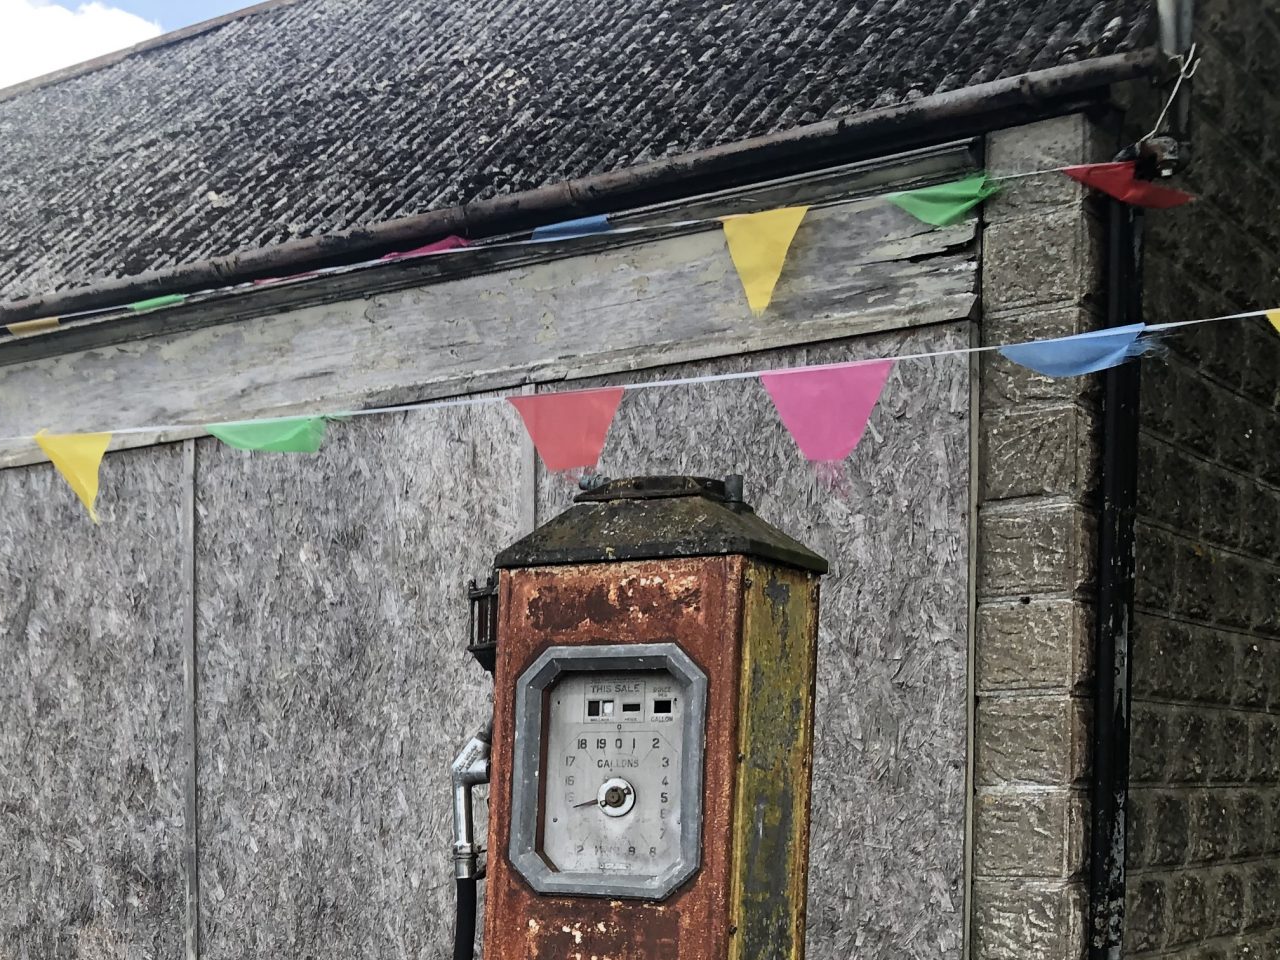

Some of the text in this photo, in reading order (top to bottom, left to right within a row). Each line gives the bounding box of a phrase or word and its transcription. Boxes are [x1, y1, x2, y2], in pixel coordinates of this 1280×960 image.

[590, 684, 640, 693] THIS SALE
[577, 738, 587, 749] 18
[596, 738, 606, 749] 19
[615, 738, 622, 749] 0
[652, 738, 660, 749] 2
[565, 756, 576, 767] 17
[597, 759, 639, 768] GALLONS
[662, 757, 669, 768] 3
[661, 776, 669, 786] 4
[660, 792, 668, 803] 5
